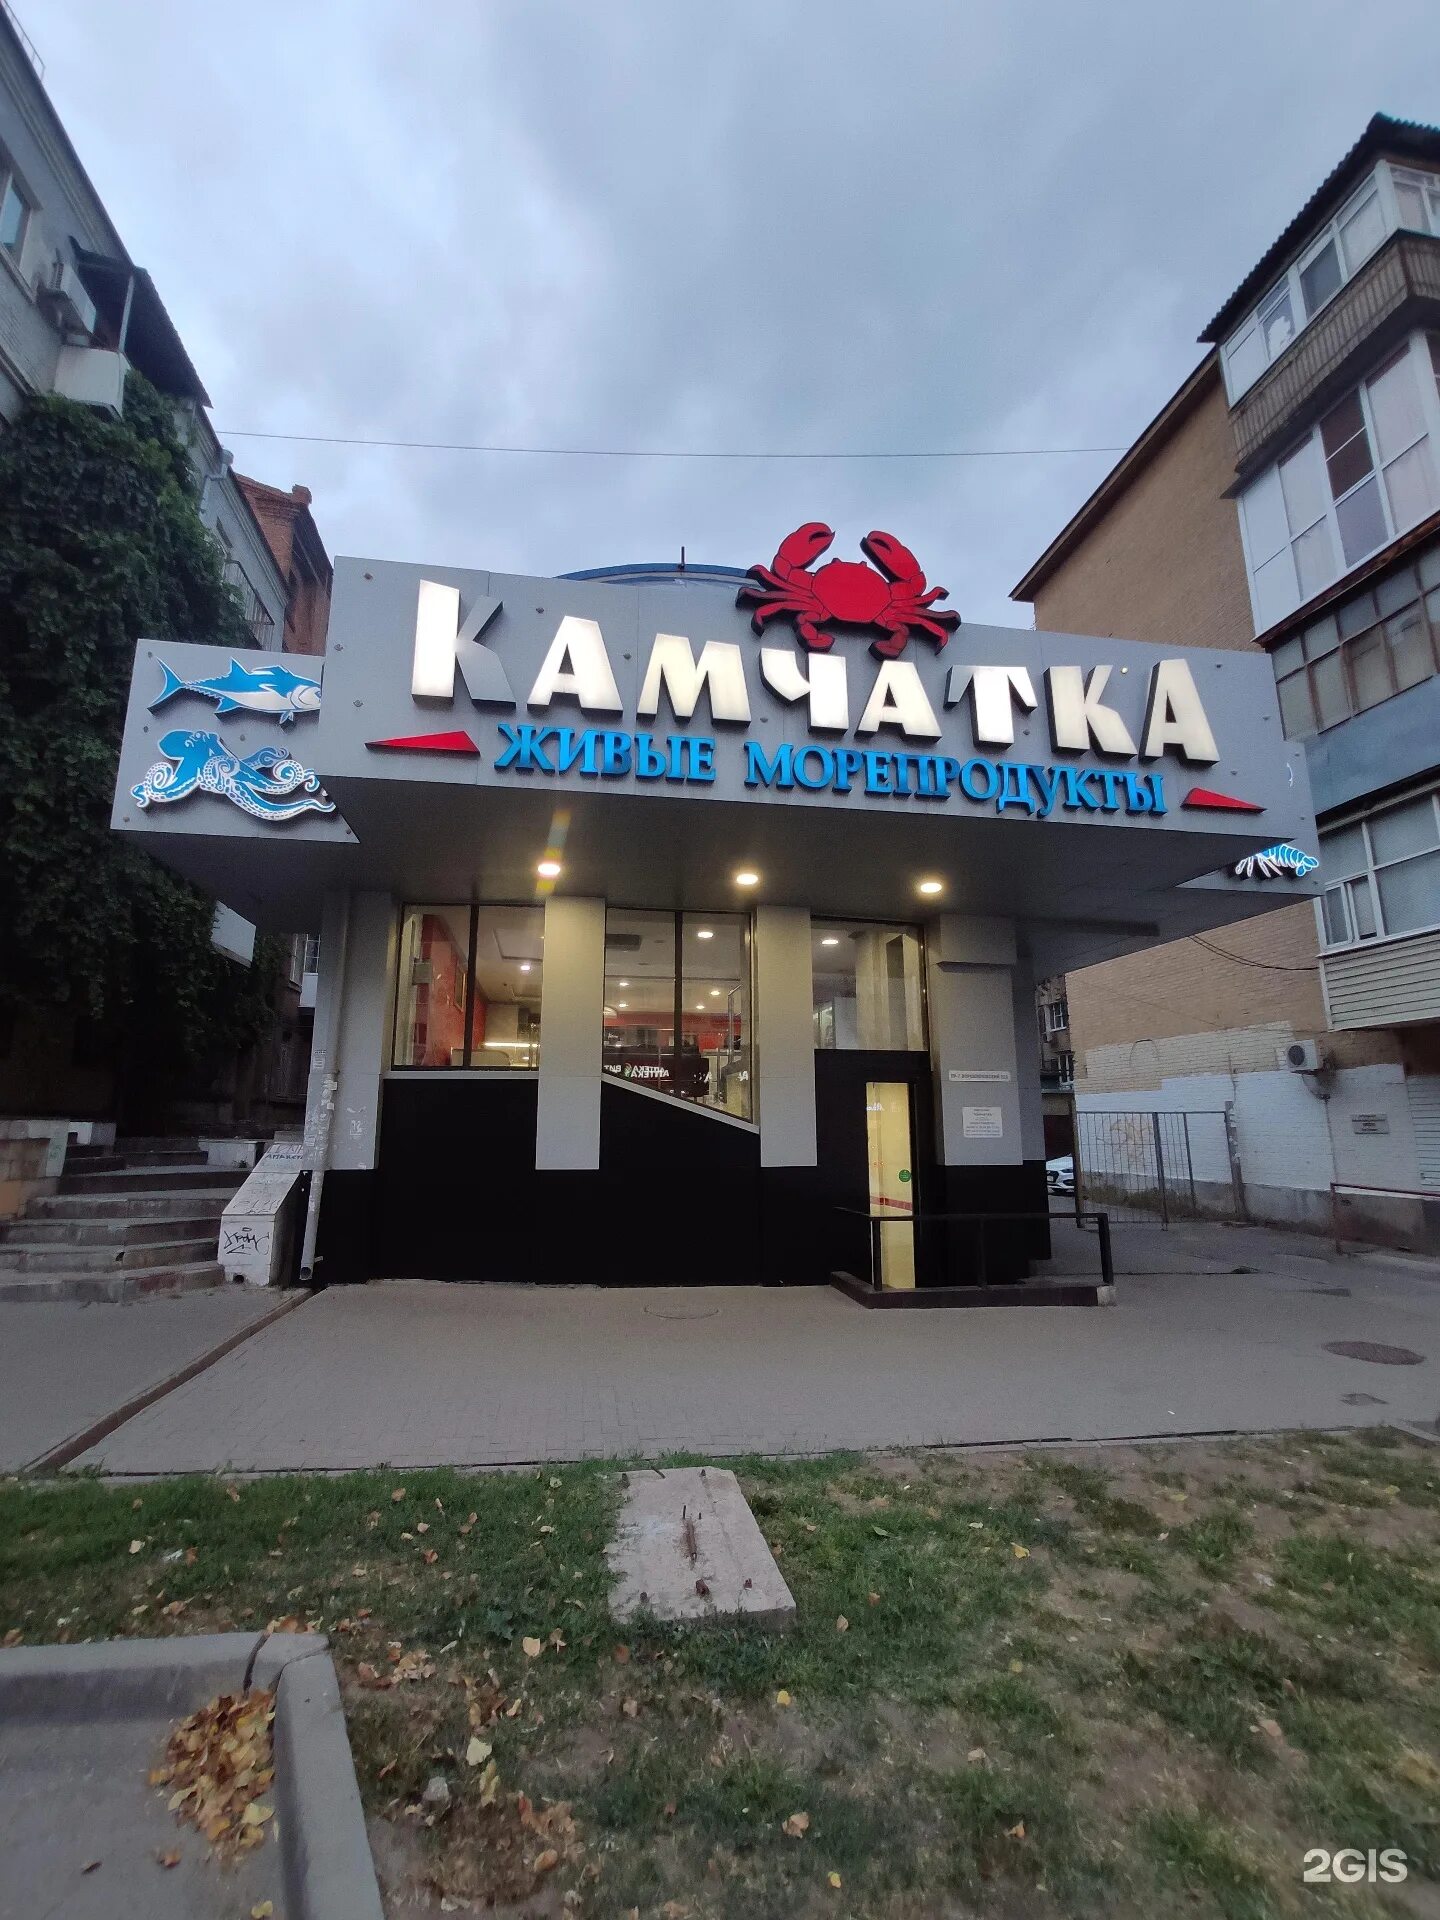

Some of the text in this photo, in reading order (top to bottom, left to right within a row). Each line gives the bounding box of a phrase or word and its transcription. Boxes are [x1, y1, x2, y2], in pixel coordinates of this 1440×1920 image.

[412, 579, 1220, 764] КАМЧАТКА
[494, 723, 1169, 817] ЖИВЫЕ МОРЕПРОДУКТЫ
